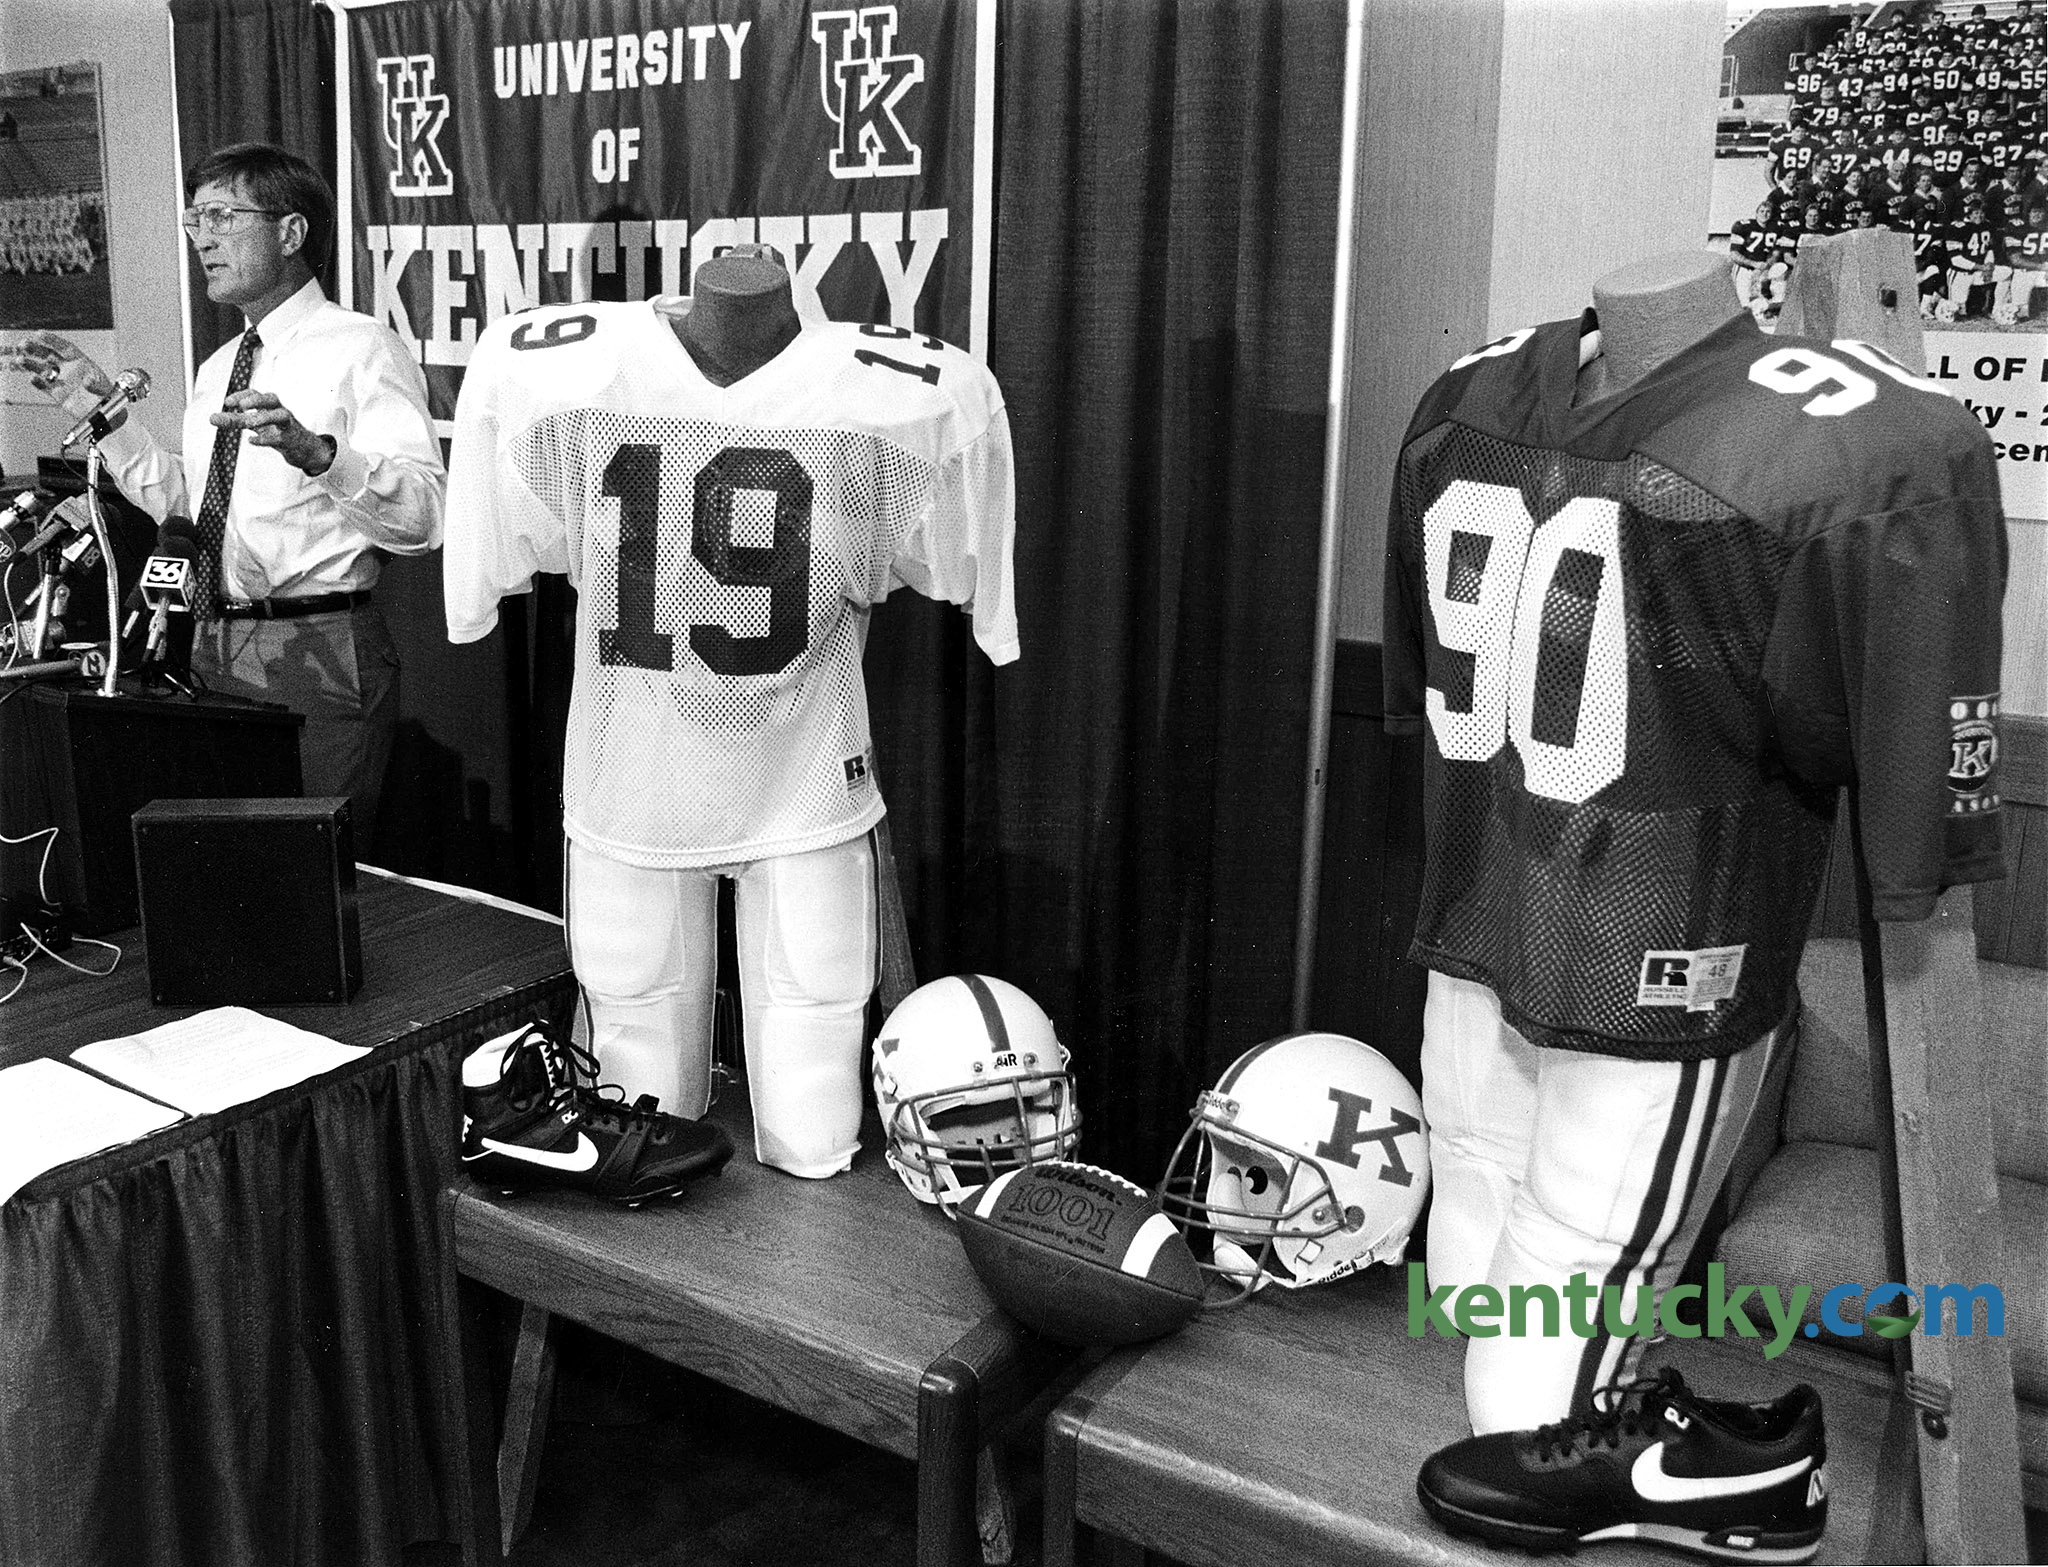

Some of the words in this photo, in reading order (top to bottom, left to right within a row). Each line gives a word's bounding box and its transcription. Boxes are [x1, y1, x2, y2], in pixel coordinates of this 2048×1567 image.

[493, 21, 752, 99] UNIVERSITY
[1797, 74, 1822, 93] 96
[1838, 78, 1863, 97] 43
[1884, 73, 1908, 92] 94
[1933, 70, 1960, 90] 50
[1975, 71, 2001, 90] 49
[2020, 70, 2047, 89] 55
[1813, 107, 1839, 126] 79
[591, 127, 641, 184] OF
[1783, 147, 1812, 168] 69
[1831, 154, 1857, 174] 37
[1882, 148, 1910, 170] 44
[1933, 151, 1963, 172] 29
[1993, 145, 2023, 167] 27
[1927, 355, 1959, 380] L
[1973, 356, 2027, 382] OF
[599, 443, 814, 677] 19
[149, 561, 182, 583] 36
[1423, 479, 1629, 804] 90
[1645, 957, 1690, 987] R
[1315, 1086, 1420, 1188] K
[1008, 1183, 1116, 1241] 1001
